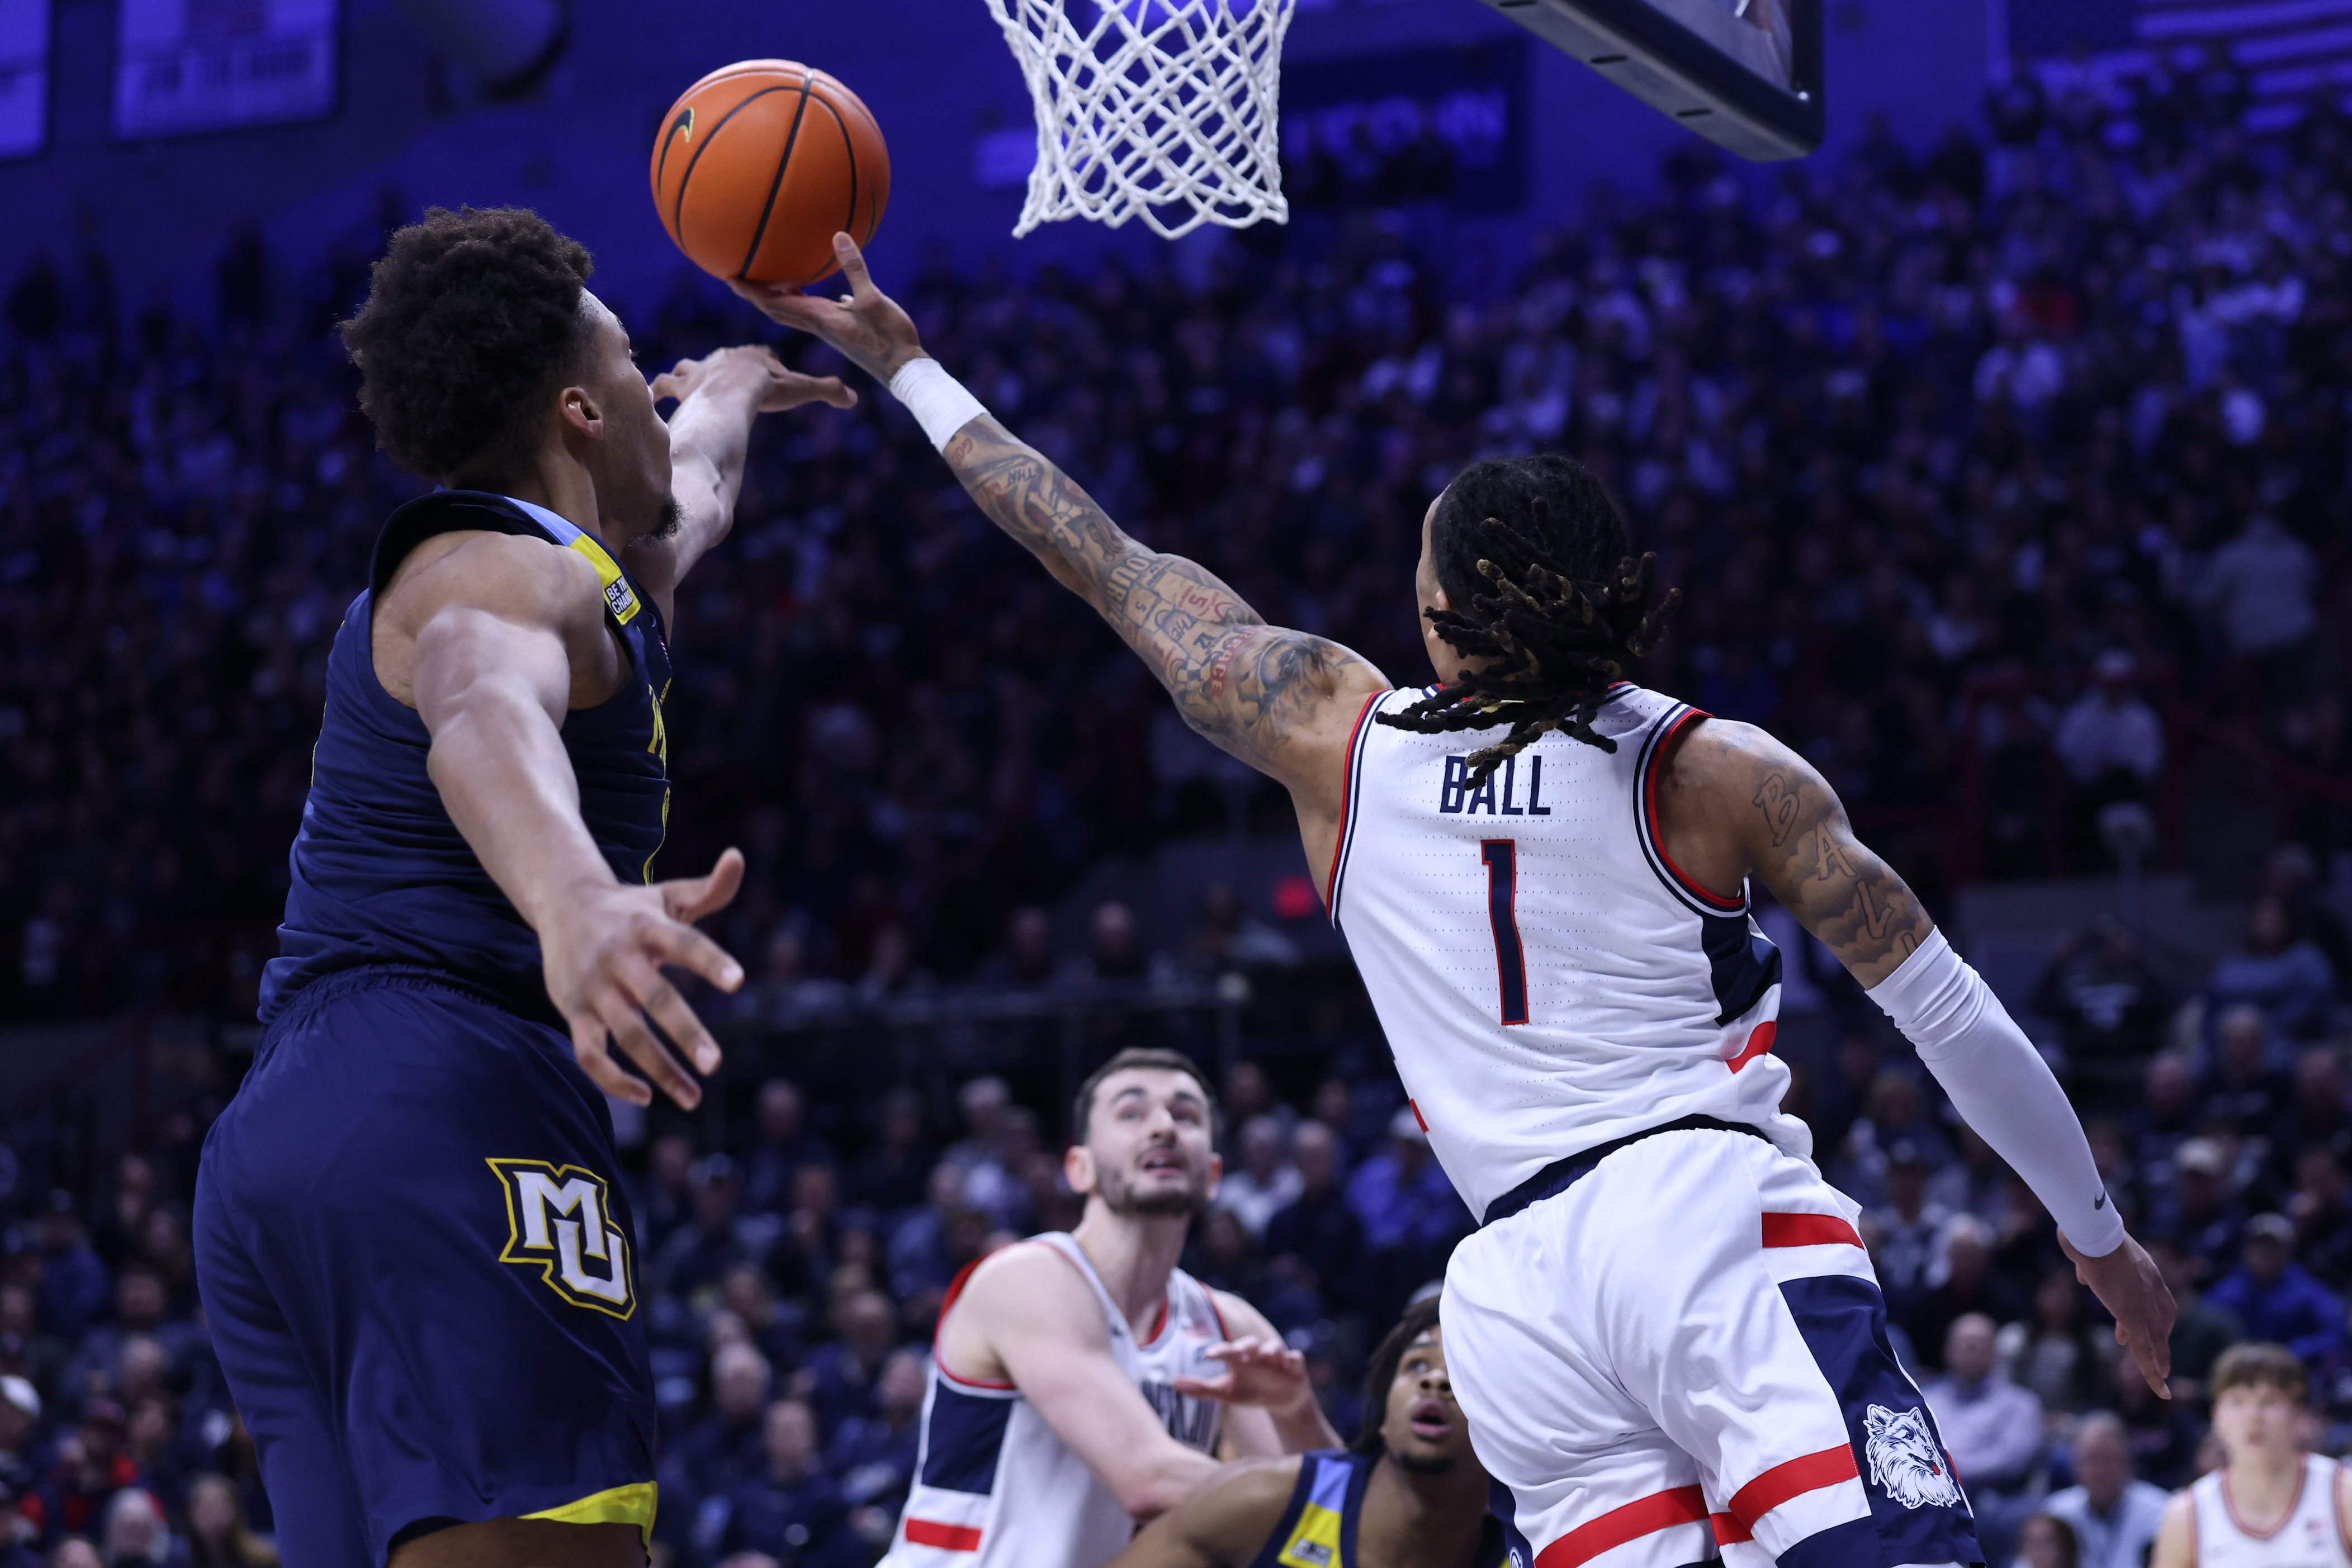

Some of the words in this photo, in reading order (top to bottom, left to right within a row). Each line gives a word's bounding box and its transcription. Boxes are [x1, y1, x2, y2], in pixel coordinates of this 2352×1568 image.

[605, 584, 621, 600] BE
[616, 576, 628, 594] TH
[1188, 594, 1210, 609] 5
[1171, 612, 1200, 642] THE
[1193, 632, 1215, 650] 12
[1439, 755, 1551, 816] BALL
[1752, 773, 1919, 957] BAL
[1480, 839, 1530, 1026] 1
[507, 1167, 631, 1309] MU
